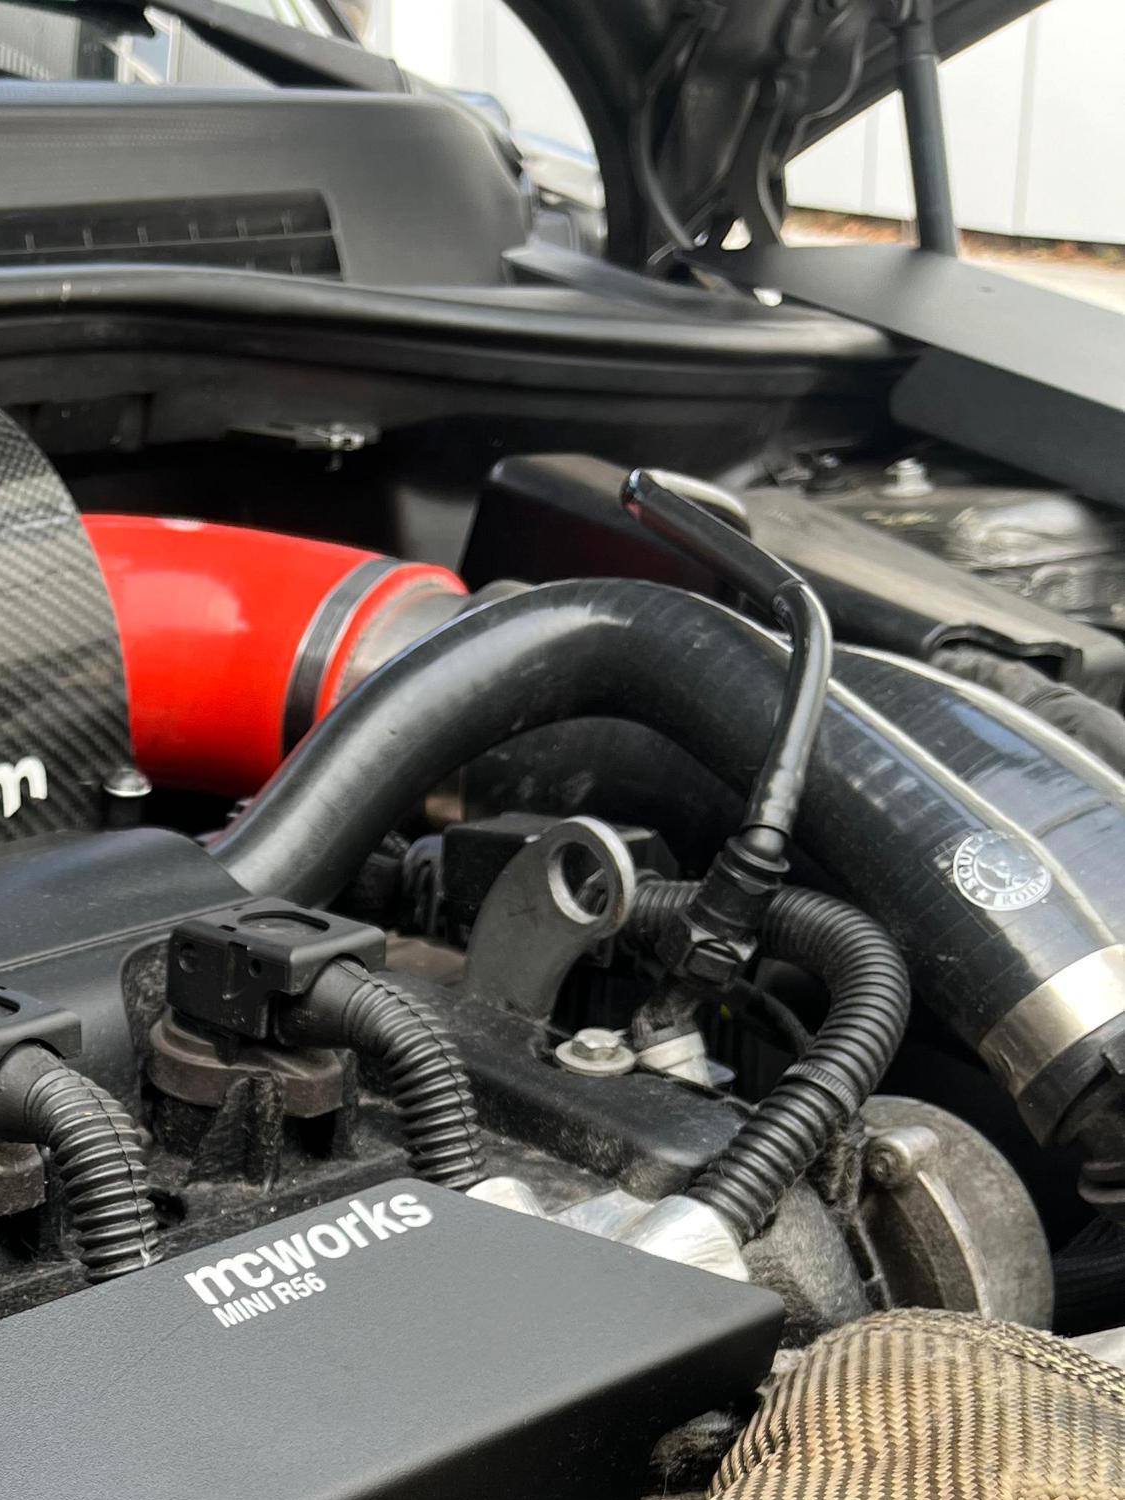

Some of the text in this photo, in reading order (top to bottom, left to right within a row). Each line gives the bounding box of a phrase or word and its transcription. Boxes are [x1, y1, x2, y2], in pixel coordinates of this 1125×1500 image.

[183, 1193, 433, 1305] mcworks
[211, 1272, 327, 1328] MINI R56
